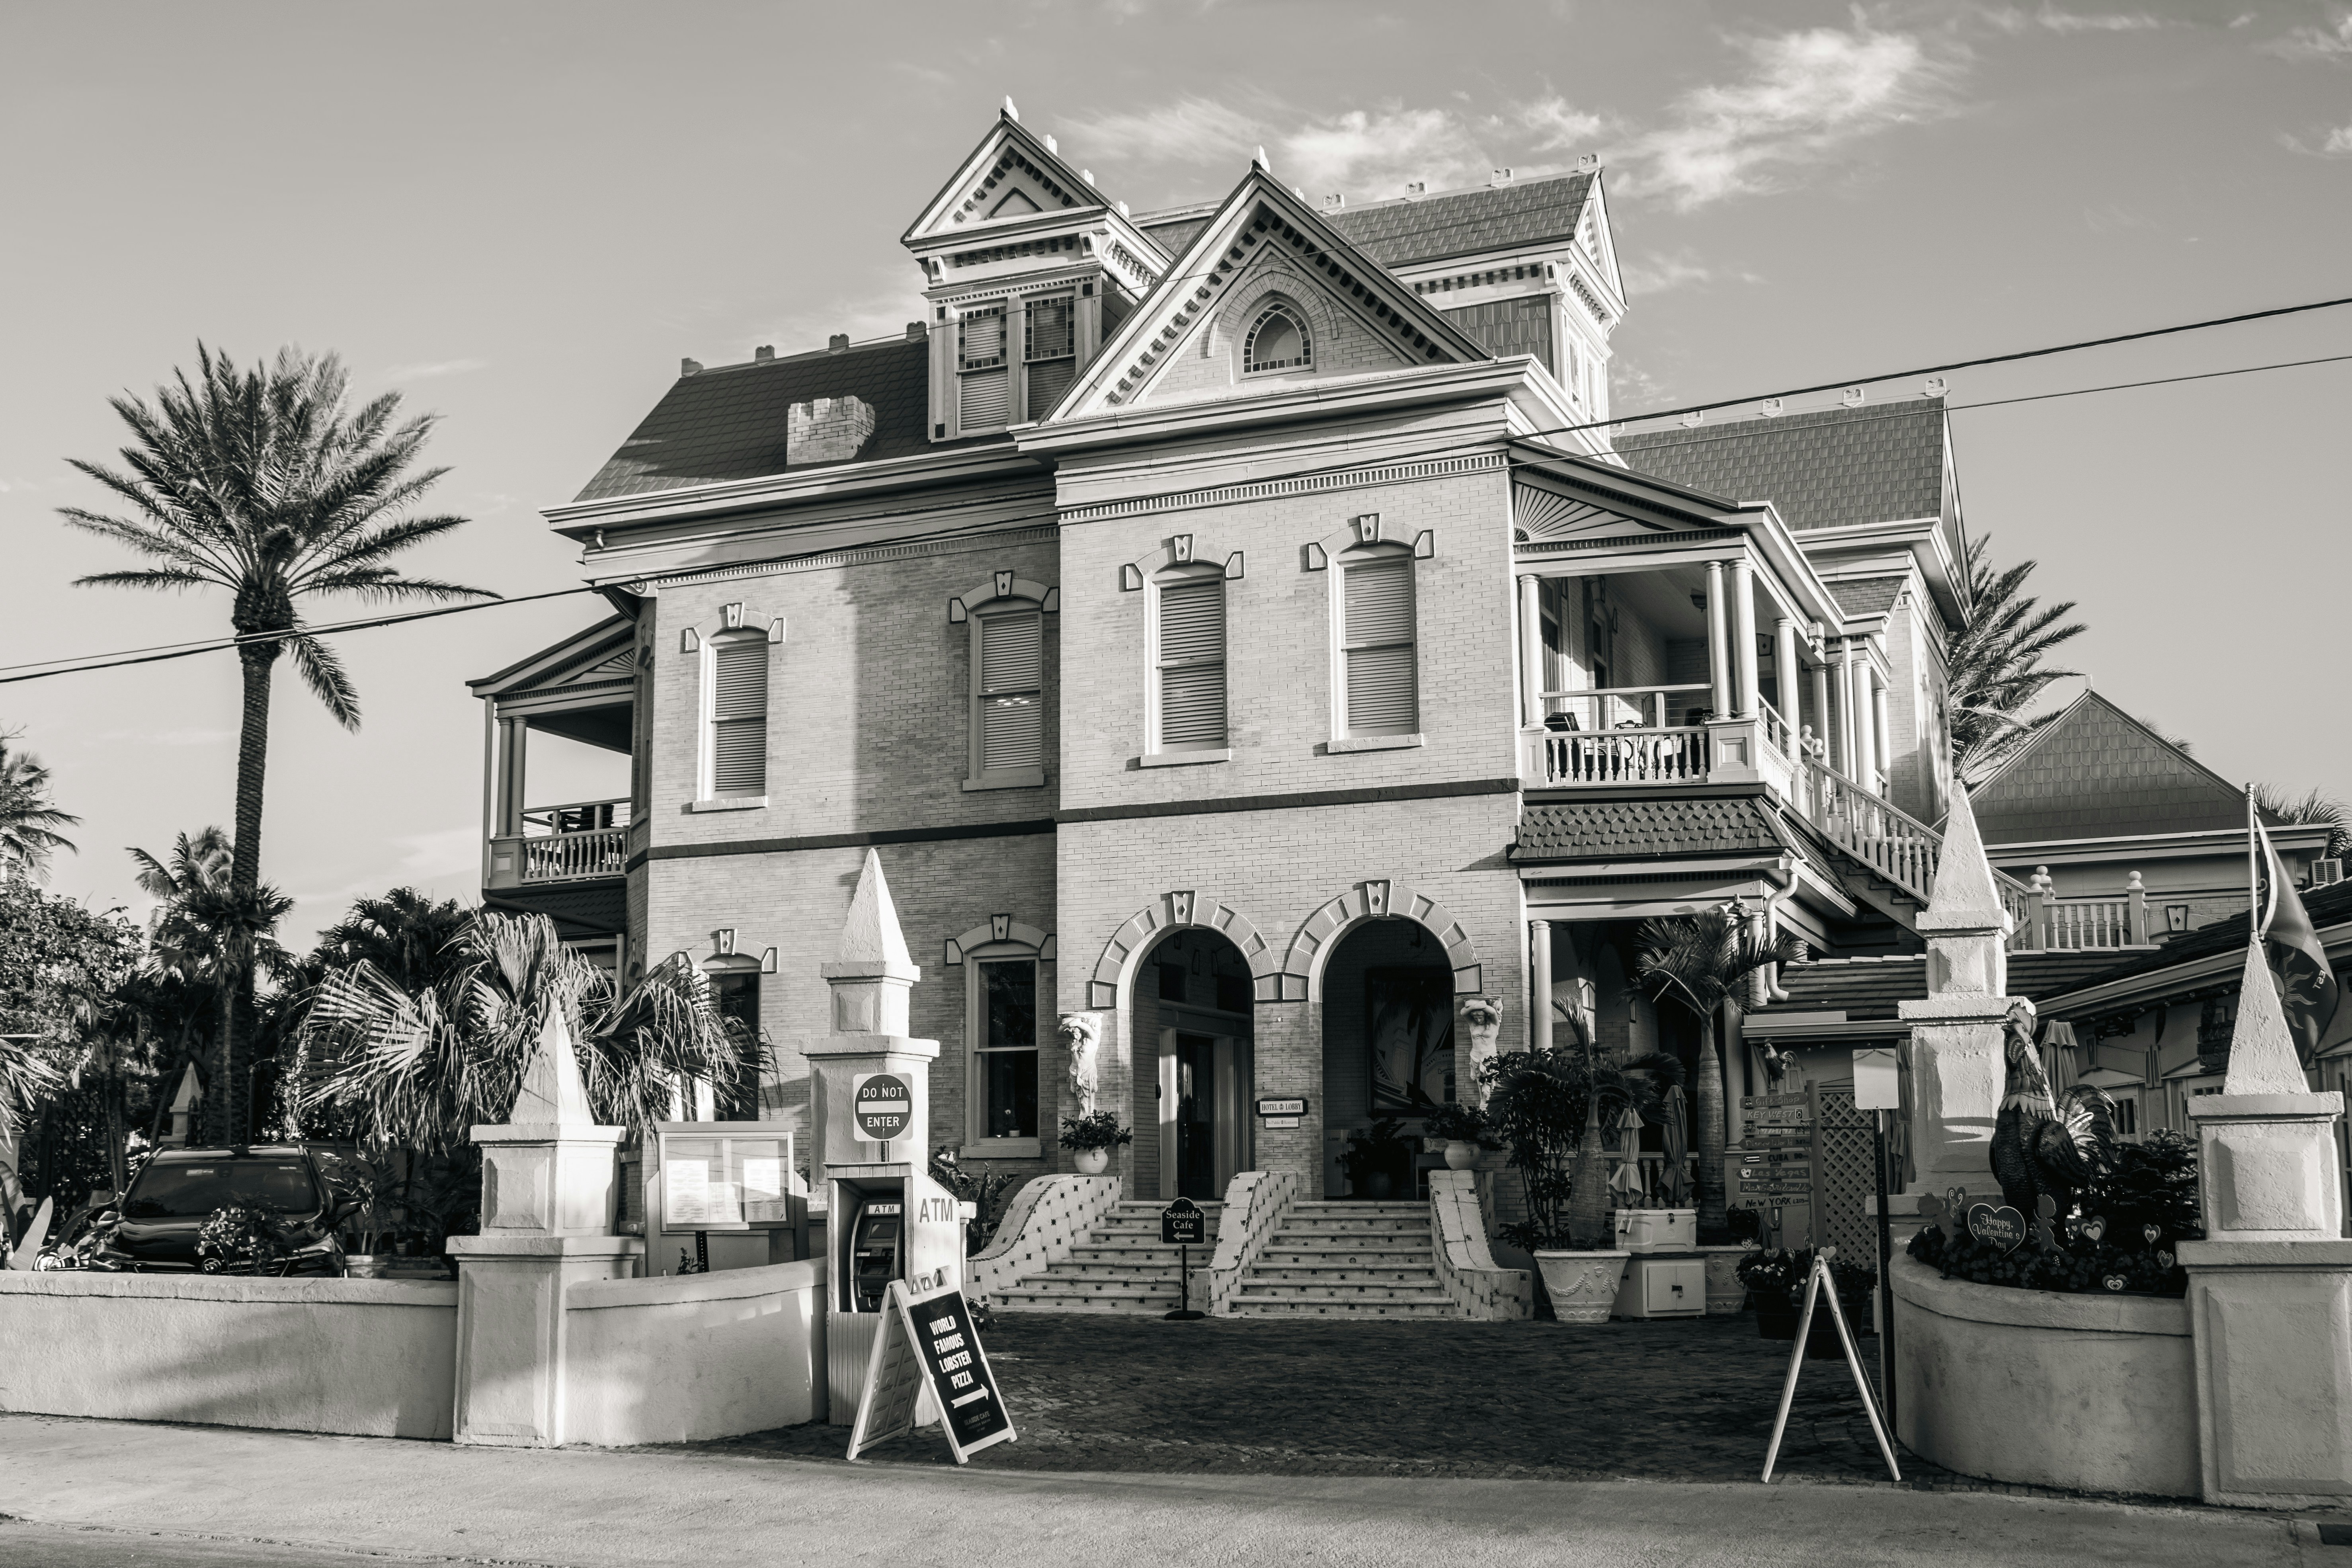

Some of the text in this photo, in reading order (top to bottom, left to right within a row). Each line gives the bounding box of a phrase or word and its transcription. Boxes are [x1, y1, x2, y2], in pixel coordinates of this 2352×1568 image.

[863, 1087, 903, 1098] DO NOT
[1755, 1097, 1774, 1105] Gift
[867, 1116, 899, 1127] ENTER
[1775, 1168, 1806, 1177] Vegas
[1768, 1197, 1791, 1206] YORK
[919, 1198, 953, 1222] ATM
[1173, 1220, 1193, 1229] Cafe
[1988, 1237, 2006, 1251] Day
[929, 1315, 956, 1336] WORLD
[934, 1333, 964, 1355] FAMOUS
[939, 1350, 972, 1373] LOBSTER
[951, 1370, 974, 1389] PIZZA
